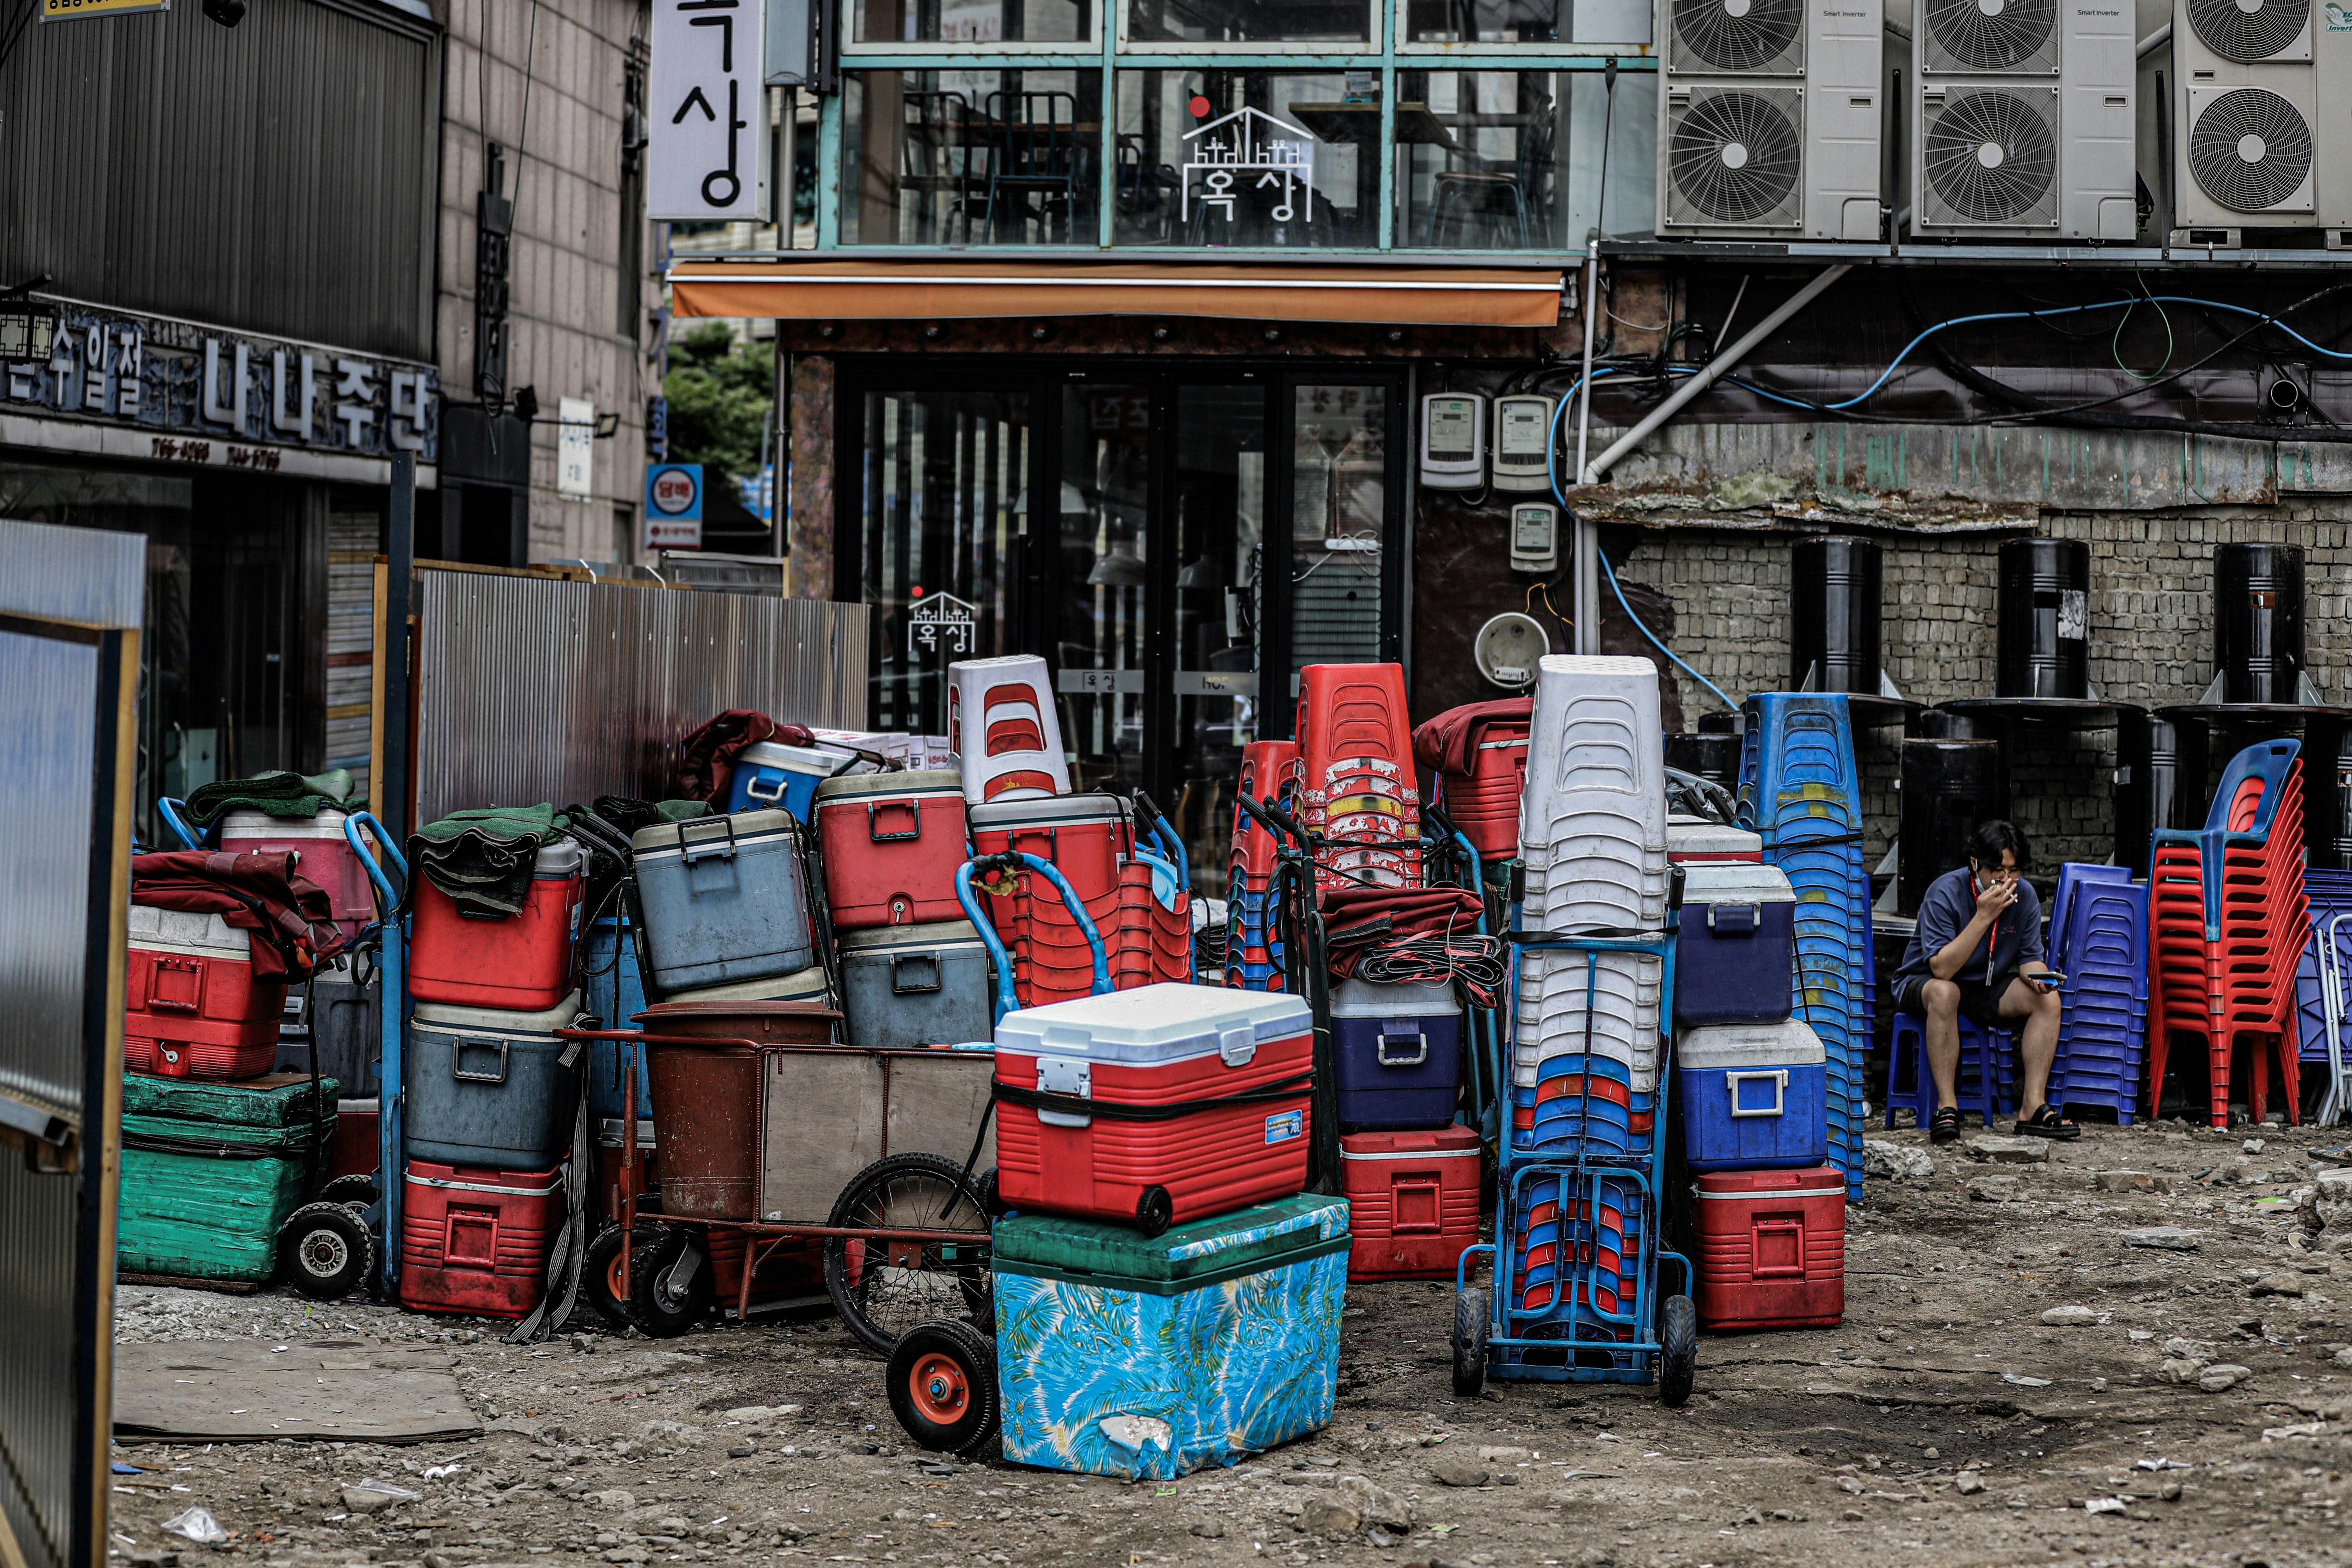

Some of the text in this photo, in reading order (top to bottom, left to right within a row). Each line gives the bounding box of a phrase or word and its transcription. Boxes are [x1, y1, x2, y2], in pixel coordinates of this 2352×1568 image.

[1200, 170, 1297, 222] 옥상
[917, 624, 968, 652] 옥상
[1087, 674, 1115, 690] 옥상
